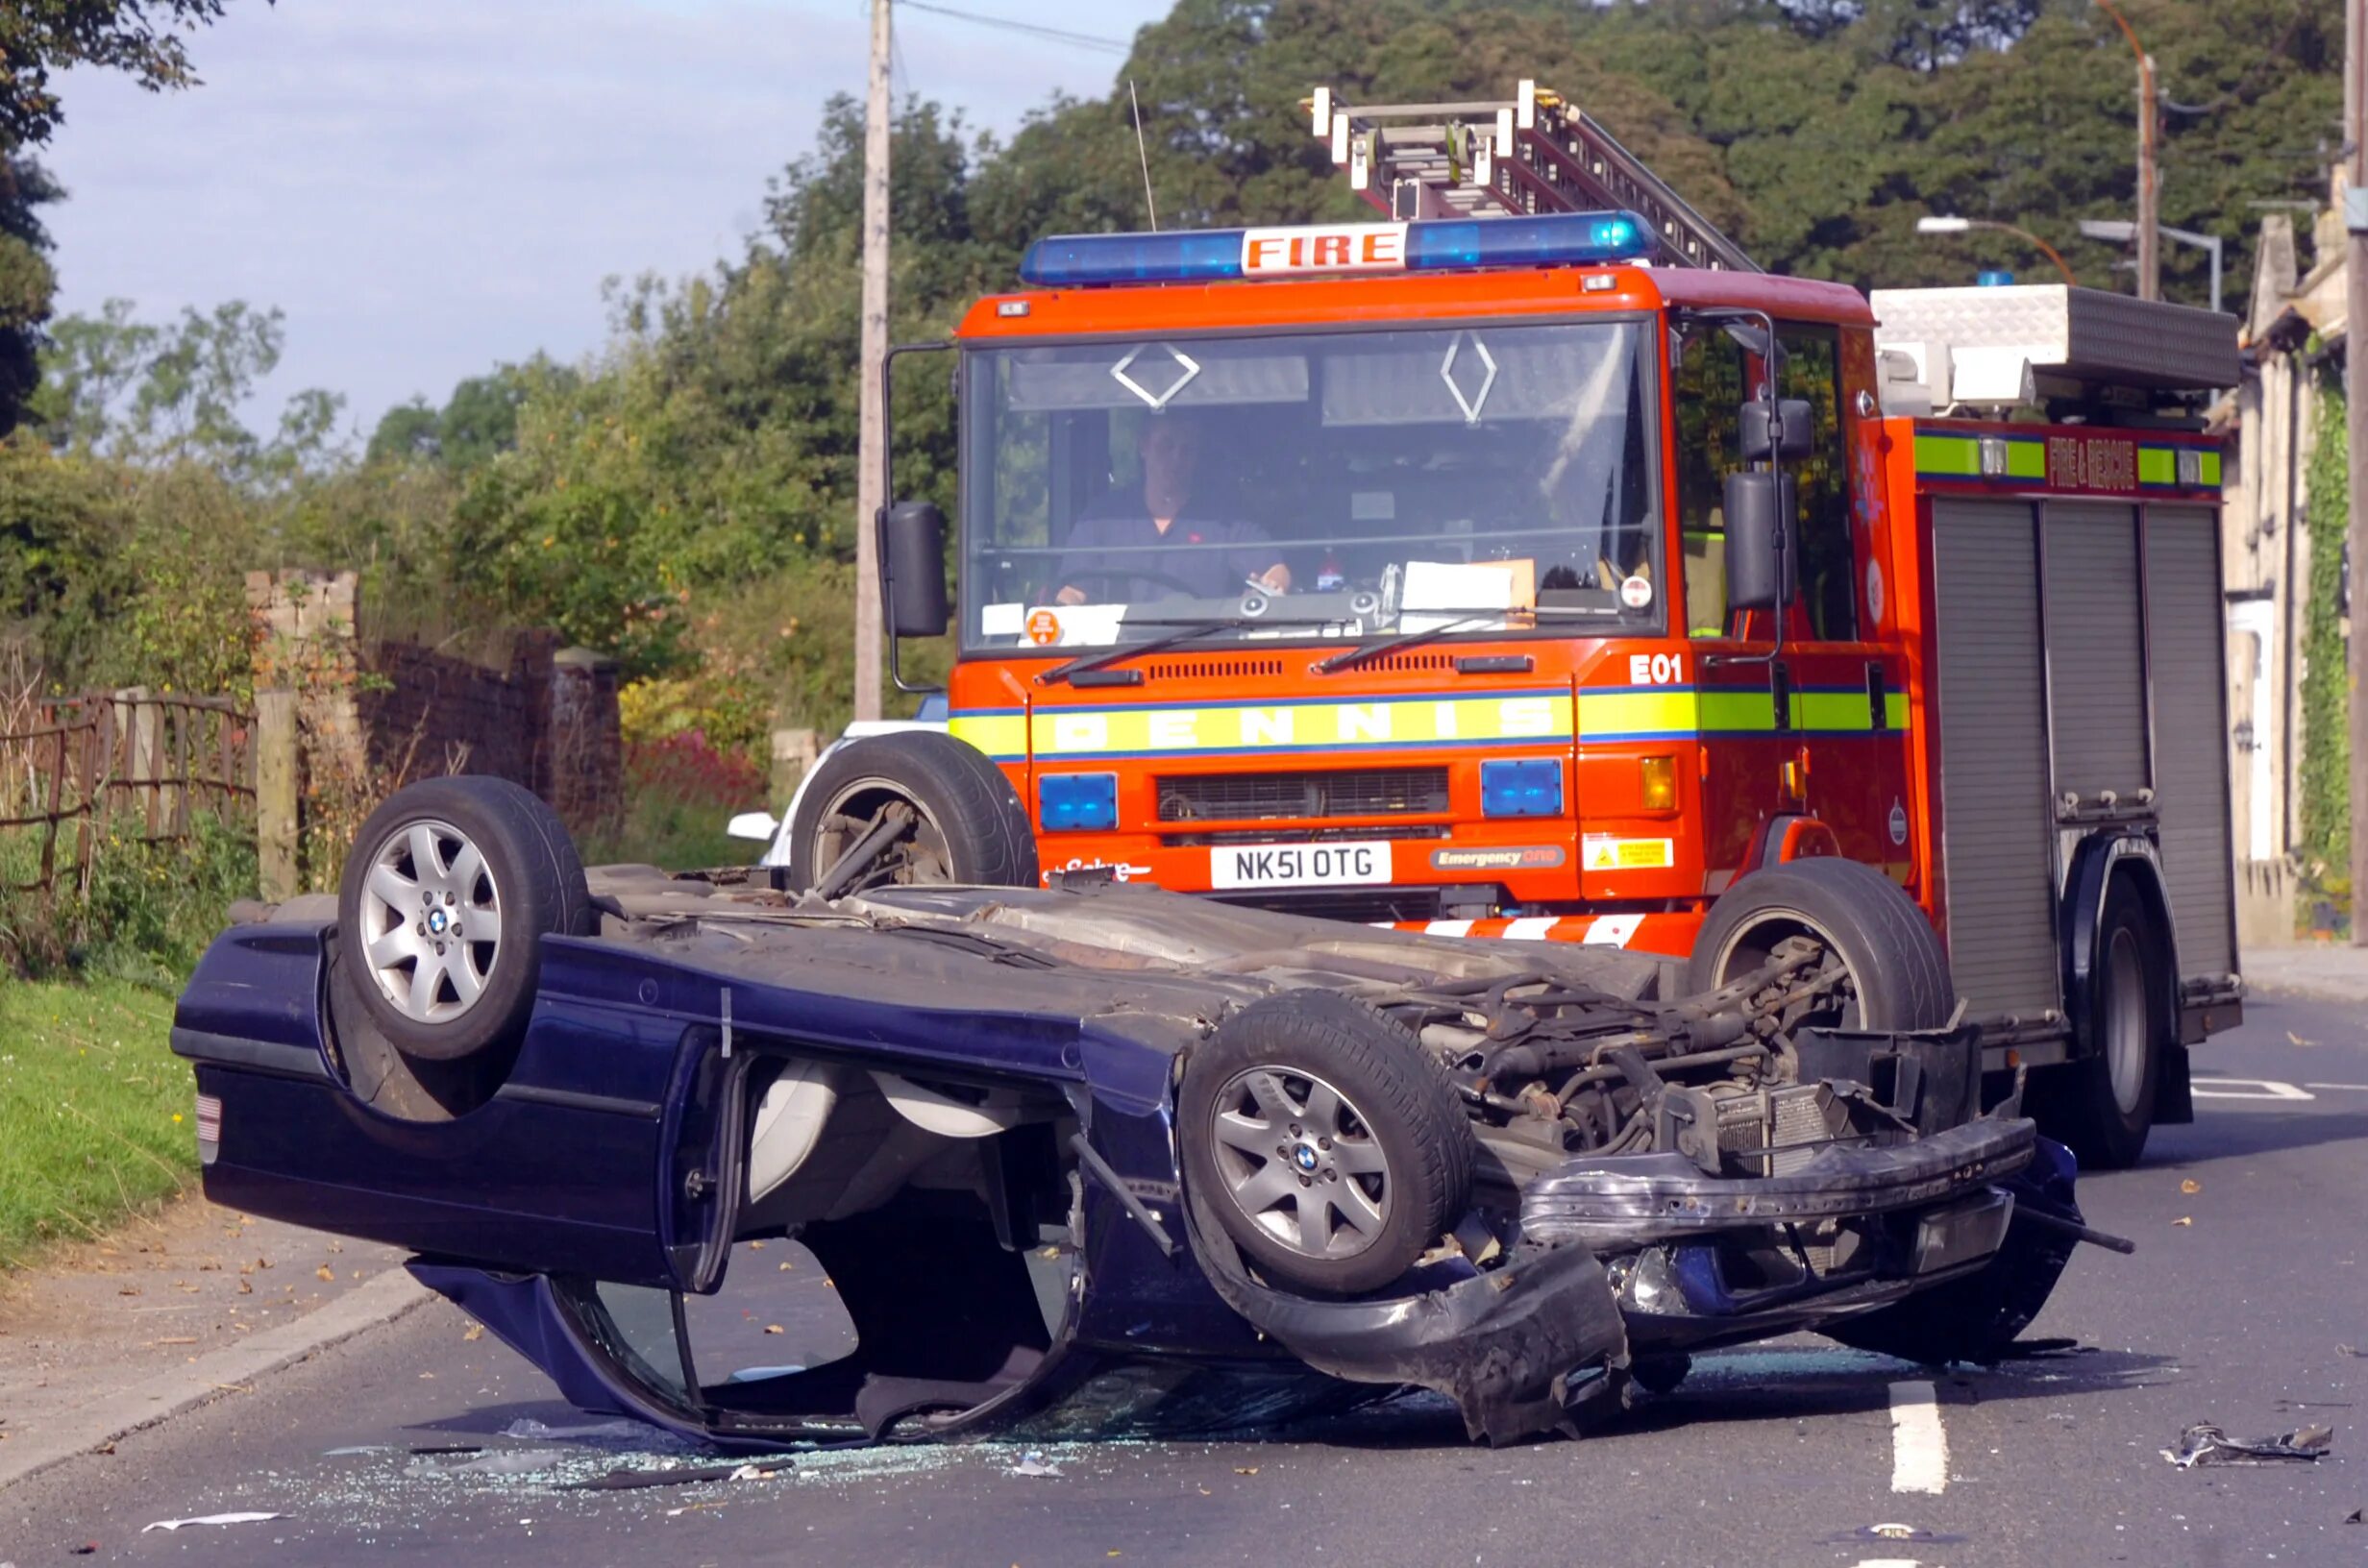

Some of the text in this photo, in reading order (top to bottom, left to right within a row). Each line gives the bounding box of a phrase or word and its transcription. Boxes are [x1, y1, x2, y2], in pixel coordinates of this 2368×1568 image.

[1247, 233, 1399, 268] FIRE
[2049, 436, 2078, 488] FIRE
[2087, 437, 2135, 491] RESCUE
[1629, 653, 1682, 685] E01
[1054, 698, 1553, 749] DENNIS
[1236, 847, 1372, 881] NK51 OTG
[1438, 850, 1522, 868] Emergency
